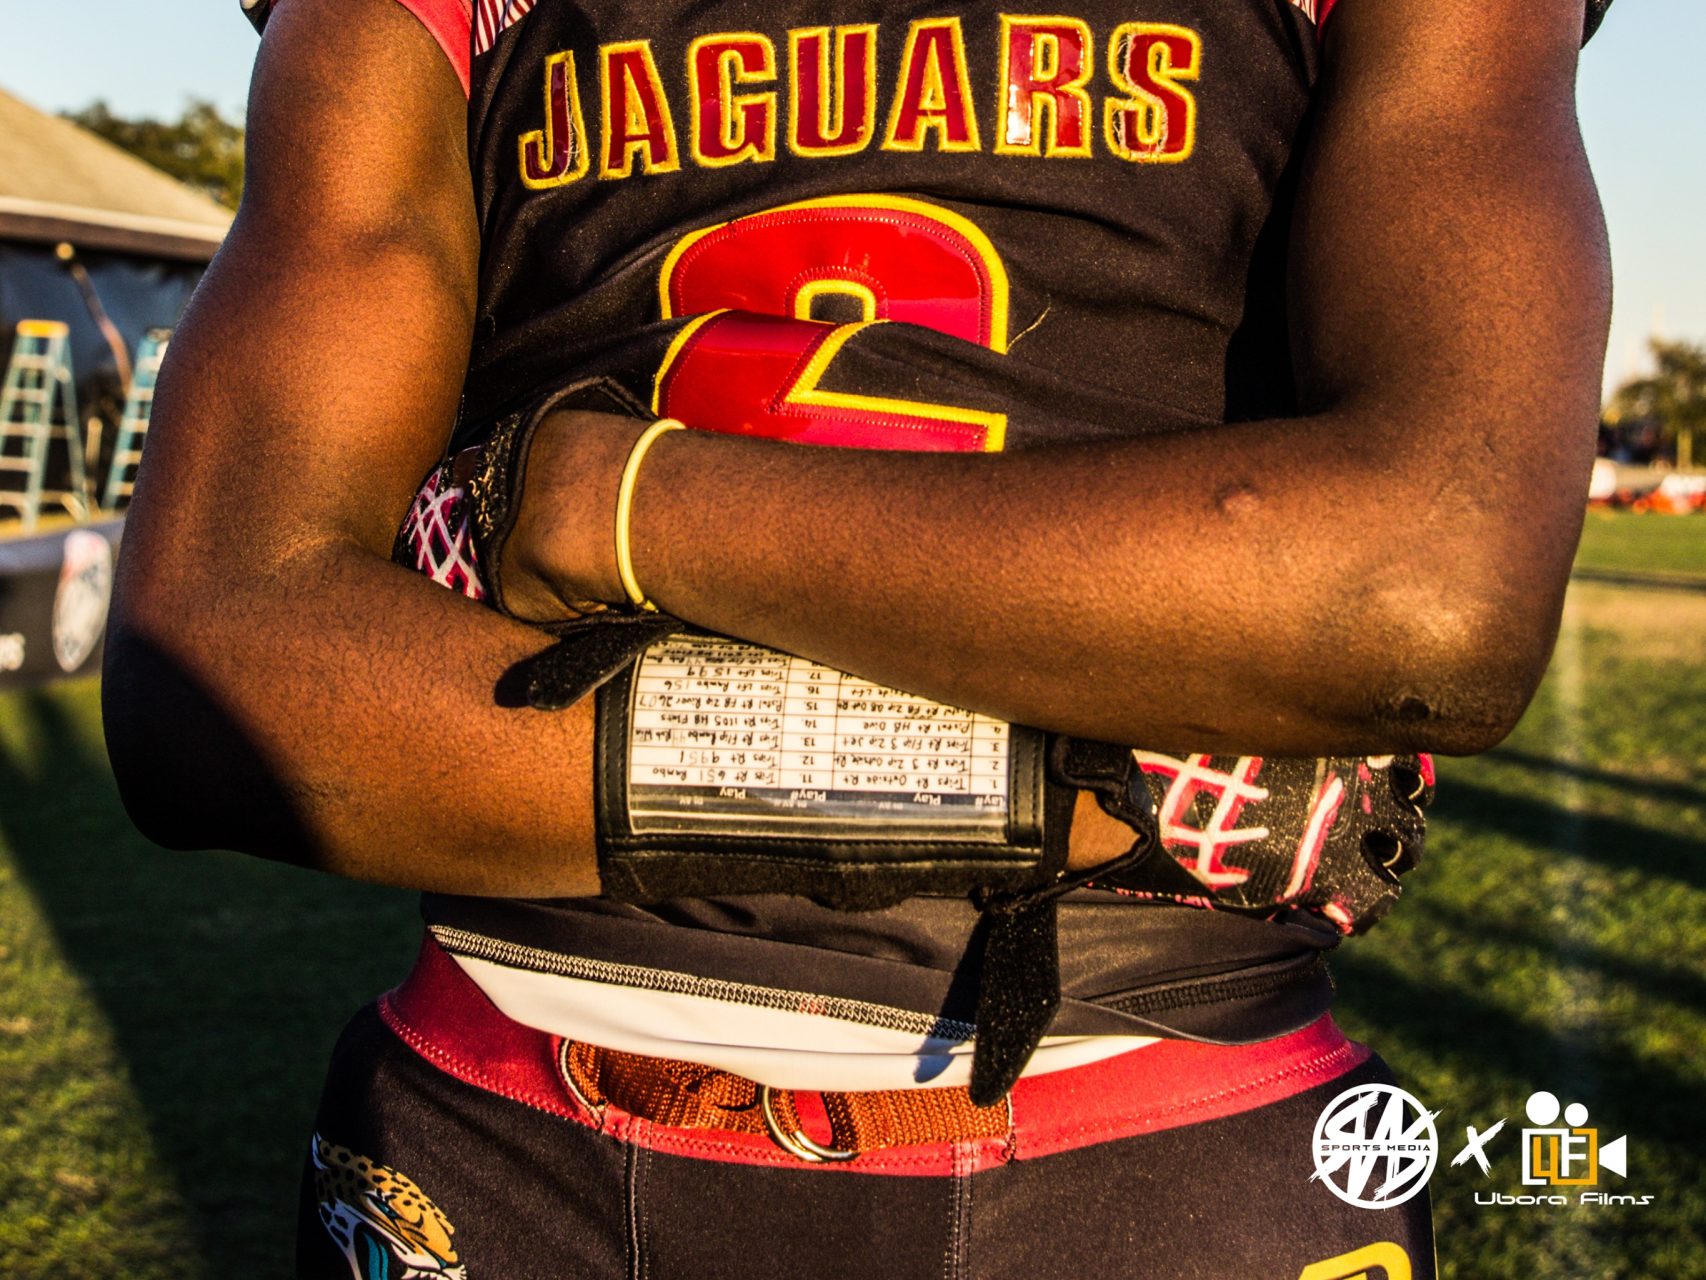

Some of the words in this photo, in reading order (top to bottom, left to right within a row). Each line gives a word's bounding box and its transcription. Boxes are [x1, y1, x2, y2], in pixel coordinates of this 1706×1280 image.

[518, 13, 1202, 190] JAGUARS
[652, 193, 1009, 453] 2
[719, 787, 747, 800] Play
[789, 790, 827, 802] Play#
[913, 793, 941, 806] Play
